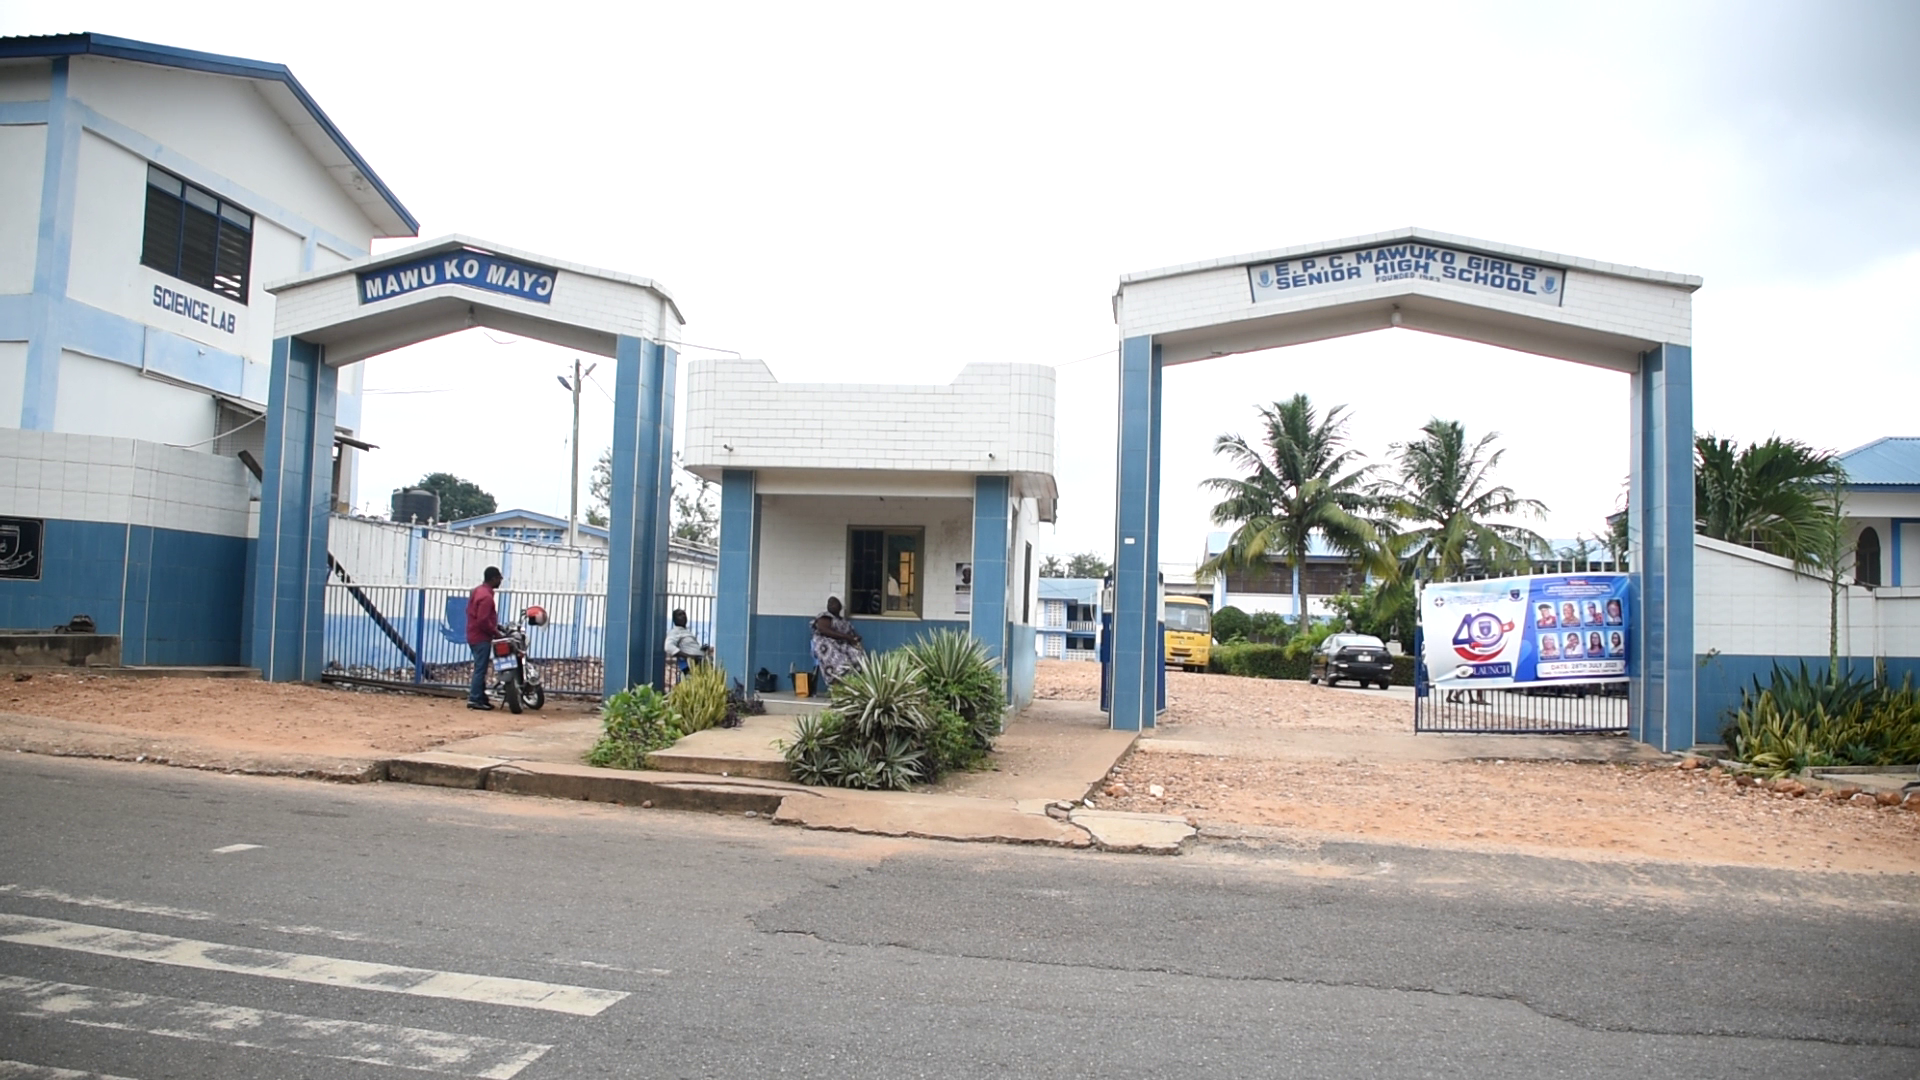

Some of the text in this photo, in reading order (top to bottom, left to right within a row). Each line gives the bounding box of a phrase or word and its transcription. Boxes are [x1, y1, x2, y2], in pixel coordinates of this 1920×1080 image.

[365, 265, 436, 298] MAWU
[444, 258, 479, 280] KO
[1276, 259, 1537, 295] SENIOR HIGH SCHOOL
[1355, 244, 1455, 265] MAWUKO
[1467, 255, 1543, 280] GIRLS'
[1375, 272, 1415, 283] FOUNDED
[153, 284, 236, 334] SCIENCE LAB
[1473, 664, 1510, 675] LAUNCH
